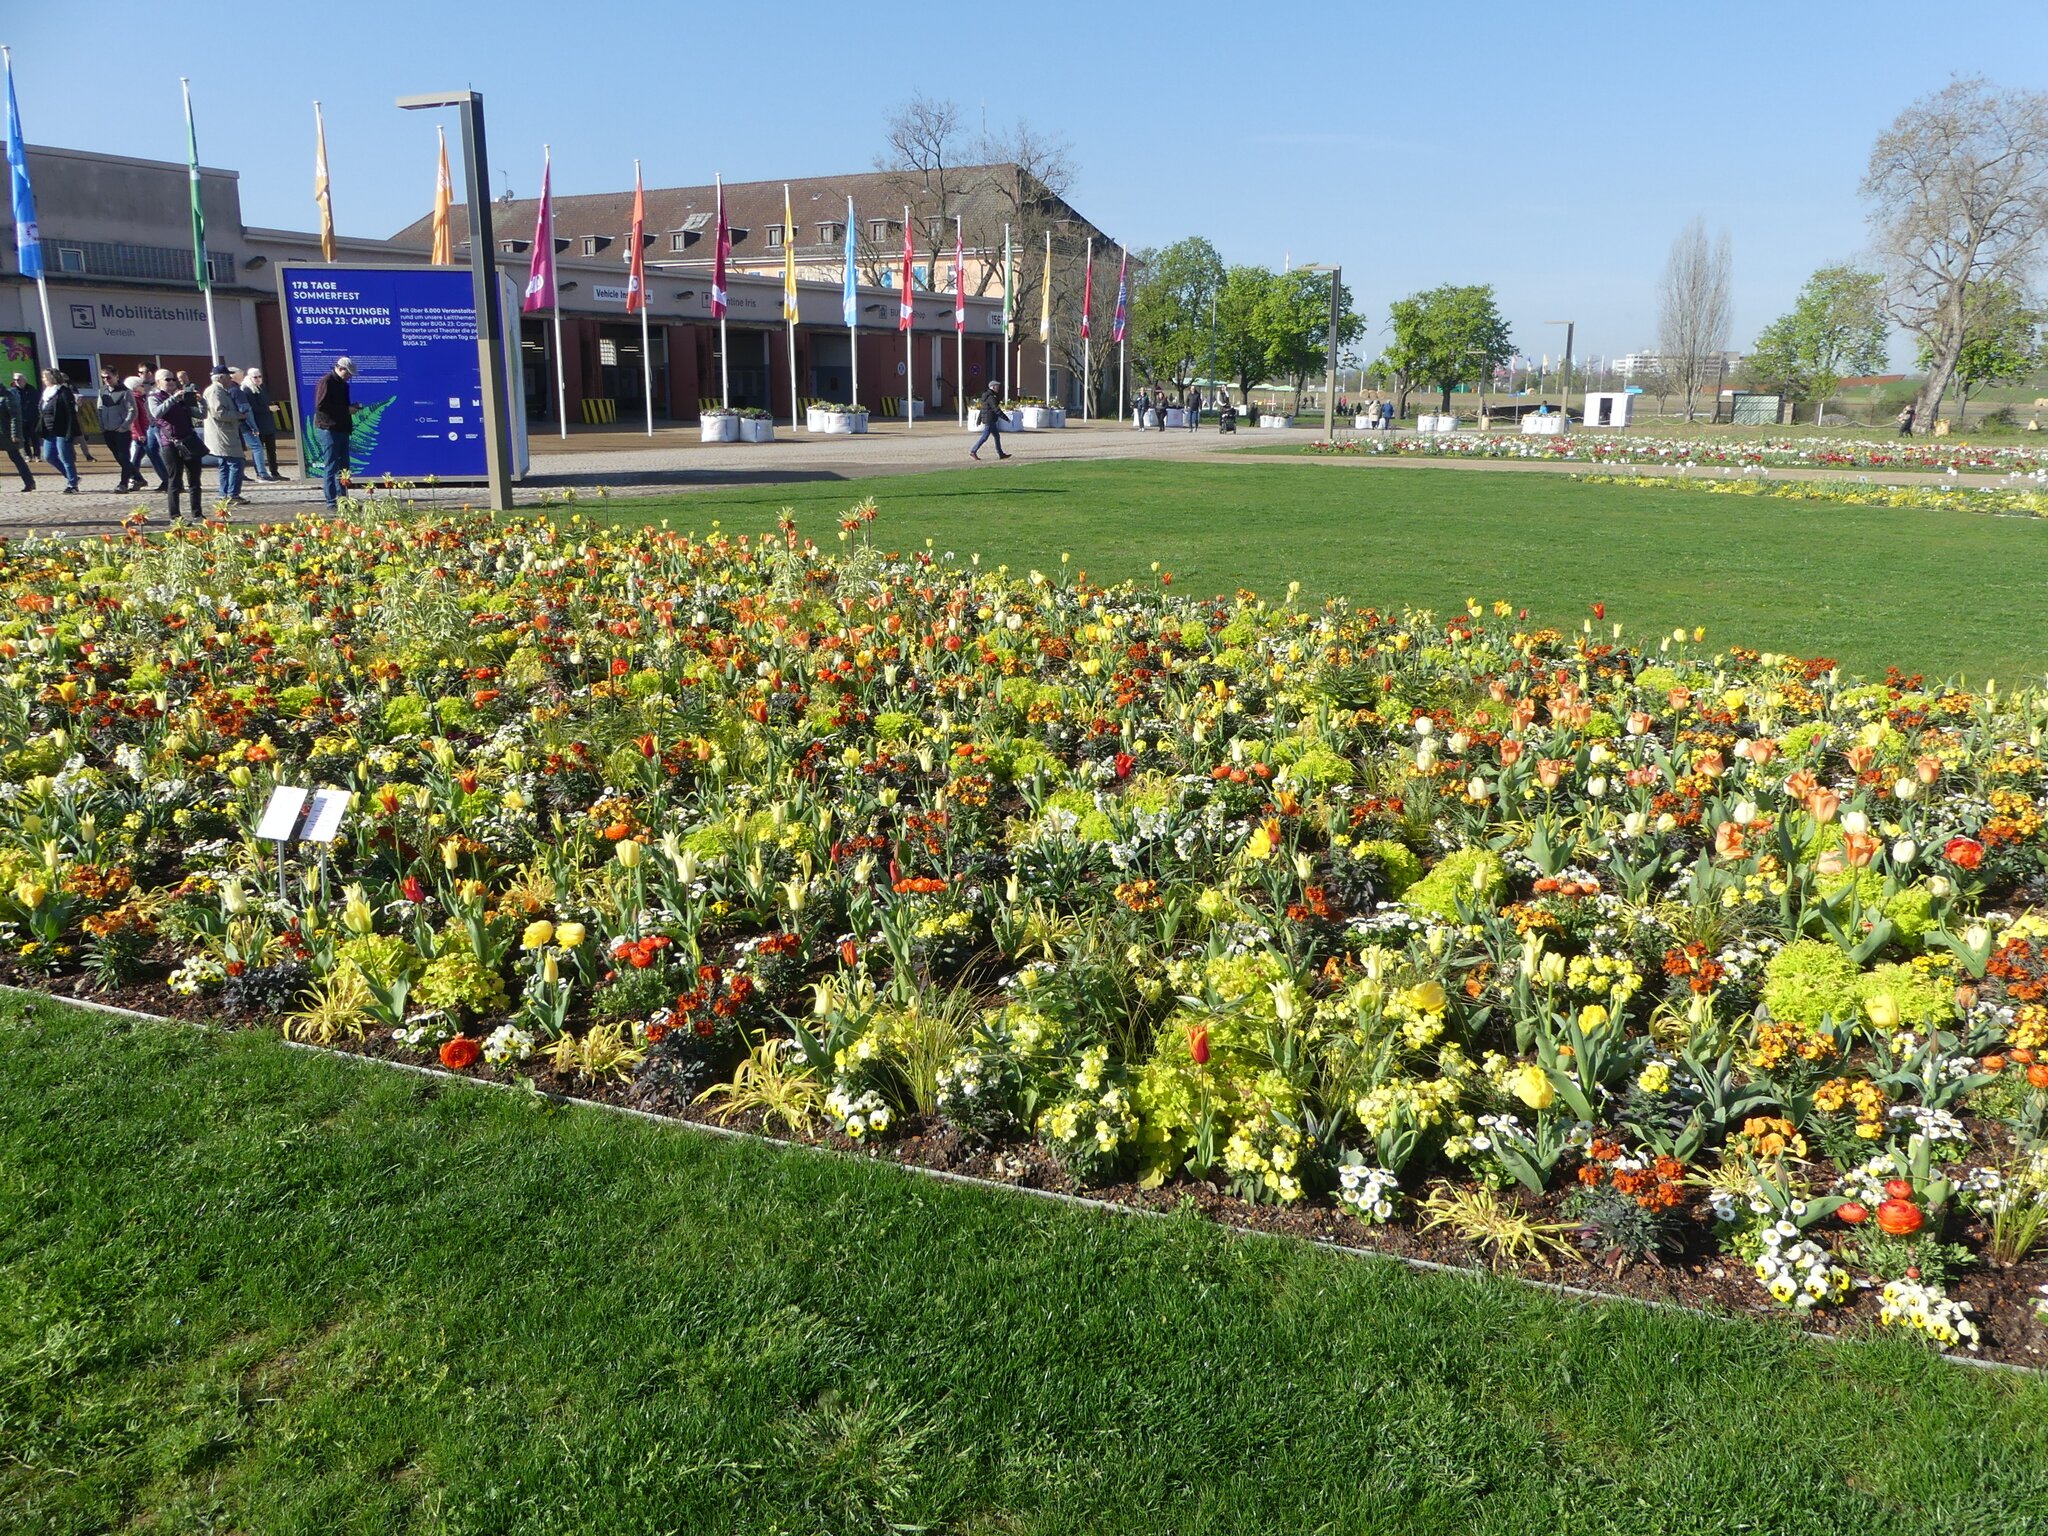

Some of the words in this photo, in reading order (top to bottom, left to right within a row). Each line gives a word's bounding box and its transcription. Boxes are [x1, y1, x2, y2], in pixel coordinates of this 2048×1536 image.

[293, 292, 360, 300] SOMMERFEST
[596, 288, 618, 298] Vehicle
[745, 298, 756, 308] Iris
[101, 304, 207, 322] Mobilitätshilfe
[295, 306, 390, 315] VERANSTALTUNGEN
[103, 327, 135, 337] Verleih
